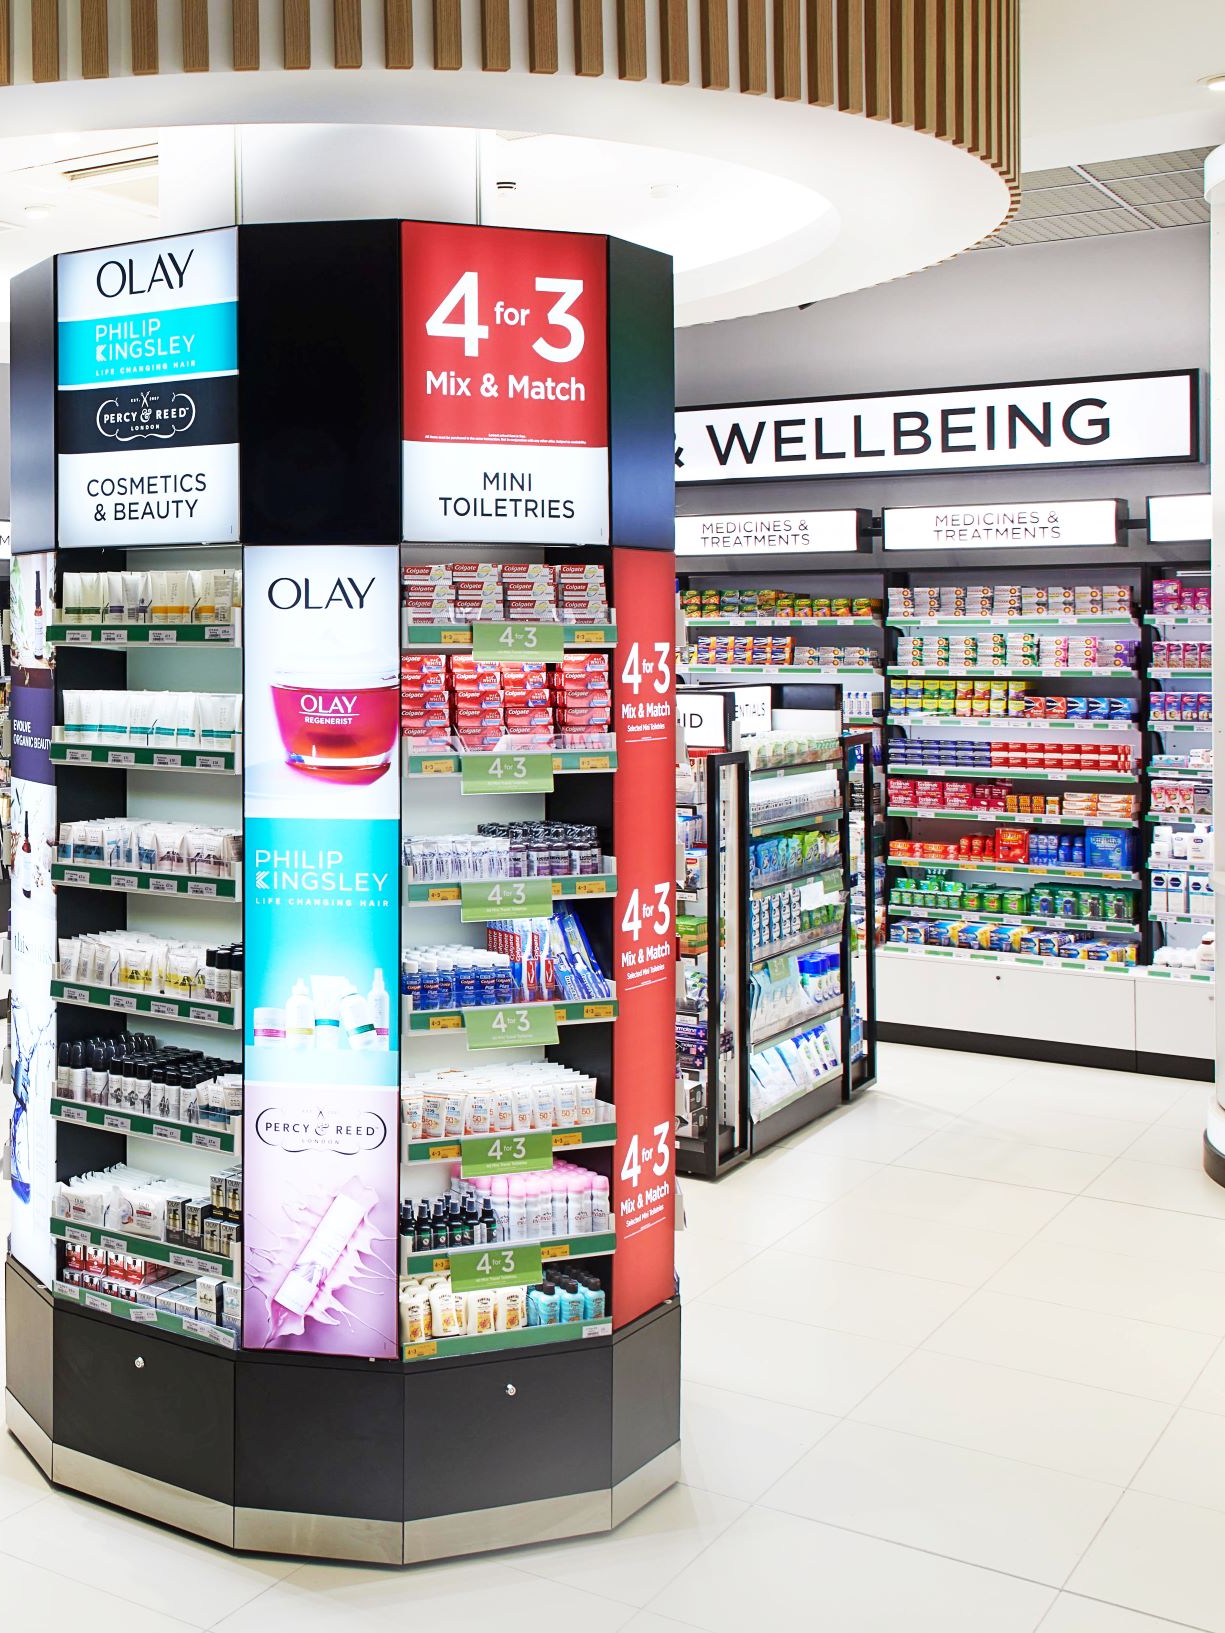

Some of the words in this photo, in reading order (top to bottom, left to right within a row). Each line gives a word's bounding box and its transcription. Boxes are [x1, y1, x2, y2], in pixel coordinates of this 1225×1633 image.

[96, 249, 194, 298] OLAY
[426, 271, 489, 357] 4
[494, 301, 530, 326] for
[532, 277, 585, 363] 3
[96, 318, 161, 342] PHILIP
[96, 334, 196, 362] KINGSLEY
[96, 369, 114, 377] LIFE
[120, 363, 168, 375] CHANGING
[173, 360, 196, 368] HAIR
[426, 370, 471, 396] Mix
[480, 373, 499, 398] &
[508, 374, 585, 401] Match
[103, 412, 137, 424] PERCY
[140, 408, 152, 423] &
[156, 407, 187, 420] REED
[705, 398, 1111, 466] WELLBEING
[87, 473, 207, 497] COSMETICS
[483, 472, 532, 491] MINI
[94, 504, 106, 522] &
[114, 499, 198, 521] BEAUTY
[439, 497, 575, 519] TOILETRIES
[935, 511, 1040, 526] MEDICINES
[1047, 510, 1060, 524] &
[702, 519, 792, 534] MEDICINES
[799, 519, 808, 531] &
[933, 526, 1062, 542] TREATMENTS
[701, 533, 810, 548] TREATMENTS
[268, 577, 376, 610] OLAY
[499, 627, 515, 647] 4
[524, 626, 537, 647] 3
[622, 642, 642, 694] 4
[642, 659, 654, 674] for
[654, 642, 670, 694] 3
[300, 695, 357, 714] OLAY
[622, 704, 636, 719] Mix
[638, 703, 644, 718] &
[646, 701, 670, 717] Match
[13, 719, 31, 733] EVOLVE
[305, 716, 353, 725] REGENERIST
[488, 758, 503, 778] 4
[513, 757, 527, 778] 3
[255, 850, 343, 869] PHILIP
[255, 871, 388, 892] KINGSLEY
[288, 898, 352, 907] CHANGING
[487, 884, 502, 905] 4
[513, 883, 525, 904] 3
[622, 888, 642, 941] 4
[642, 904, 654, 918] for
[654, 882, 670, 935] 3
[622, 951, 636, 967] Mix
[638, 948, 644, 963] &
[646, 941, 670, 960] Match
[492, 1012, 507, 1032] 4
[516, 1010, 530, 1032] 3
[266, 1122, 309, 1133] PERCY
[336, 1125, 375, 1137] REED
[487, 1139, 503, 1160] 4
[513, 1137, 526, 1159] 3
[621, 1134, 641, 1187] 4
[642, 1147, 653, 1162] for
[653, 1120, 670, 1176] 3
[621, 1198, 635, 1216] Mix
[637, 1193, 643, 1208] &
[645, 1181, 669, 1205] Match
[476, 1253, 492, 1274] 4
[501, 1250, 515, 1272] 3
